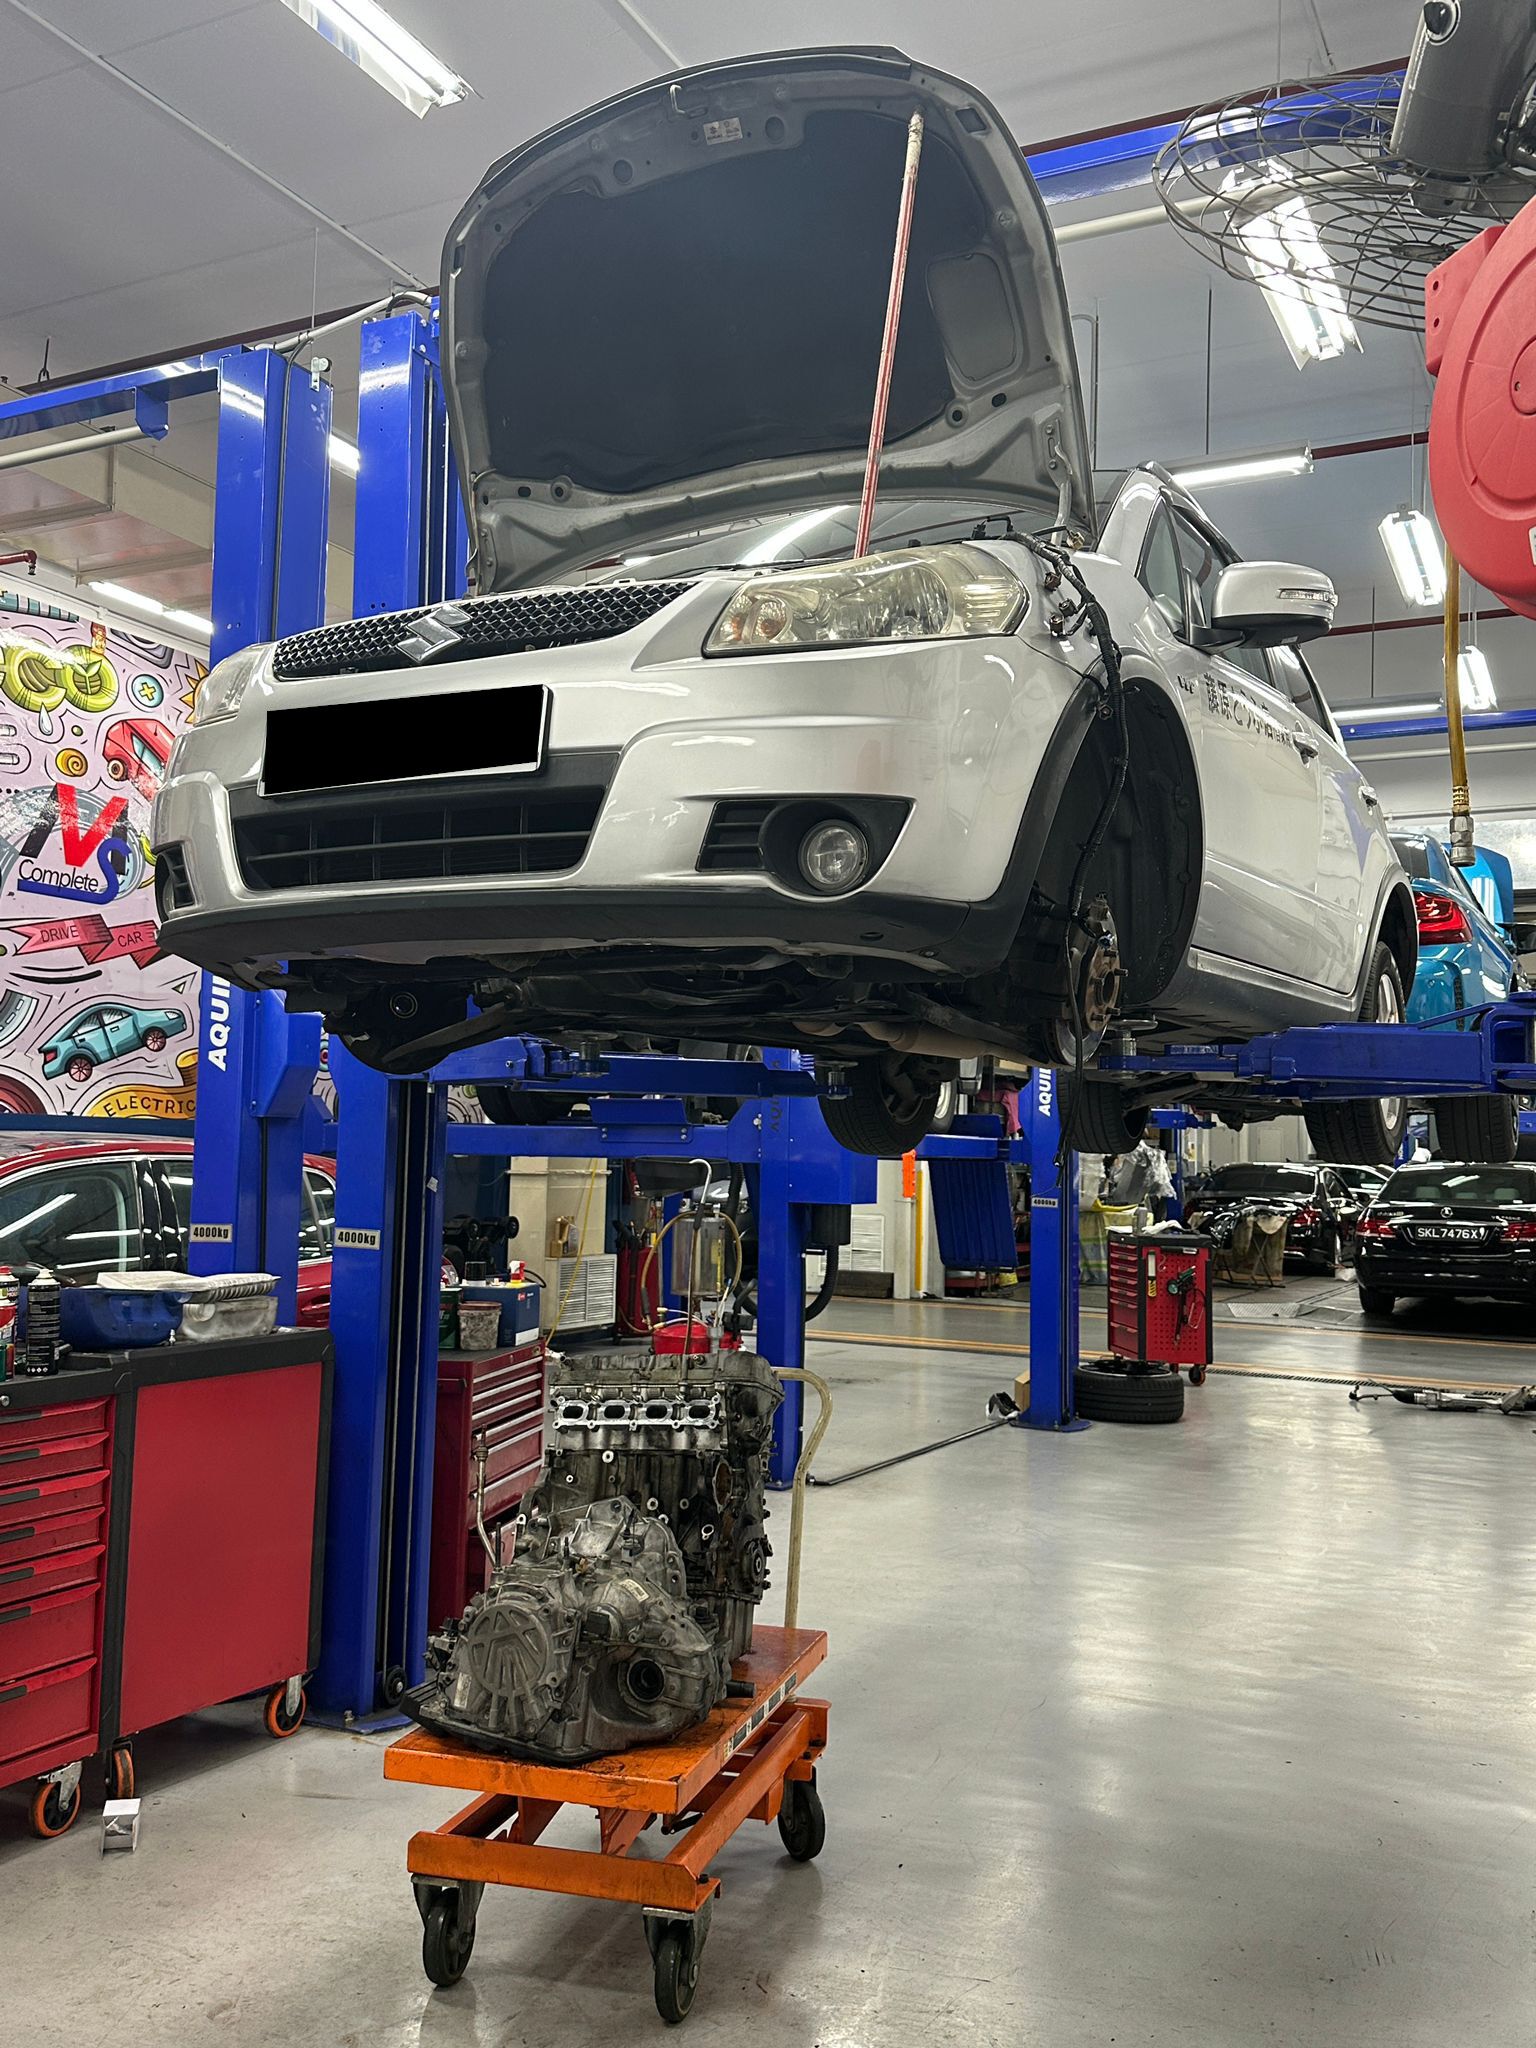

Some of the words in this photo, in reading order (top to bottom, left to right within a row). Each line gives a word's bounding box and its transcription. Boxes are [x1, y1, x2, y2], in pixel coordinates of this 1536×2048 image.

[0, 645, 119, 713] CO
[19, 859, 99, 892] Complete
[40, 925, 79, 943] DRIVE
[117, 931, 144, 948] CAR
[193, 1227, 229, 1239] 4000kg
[337, 1231, 376, 1246] 4000kg
[1417, 1227, 1479, 1239] SKL7476X
